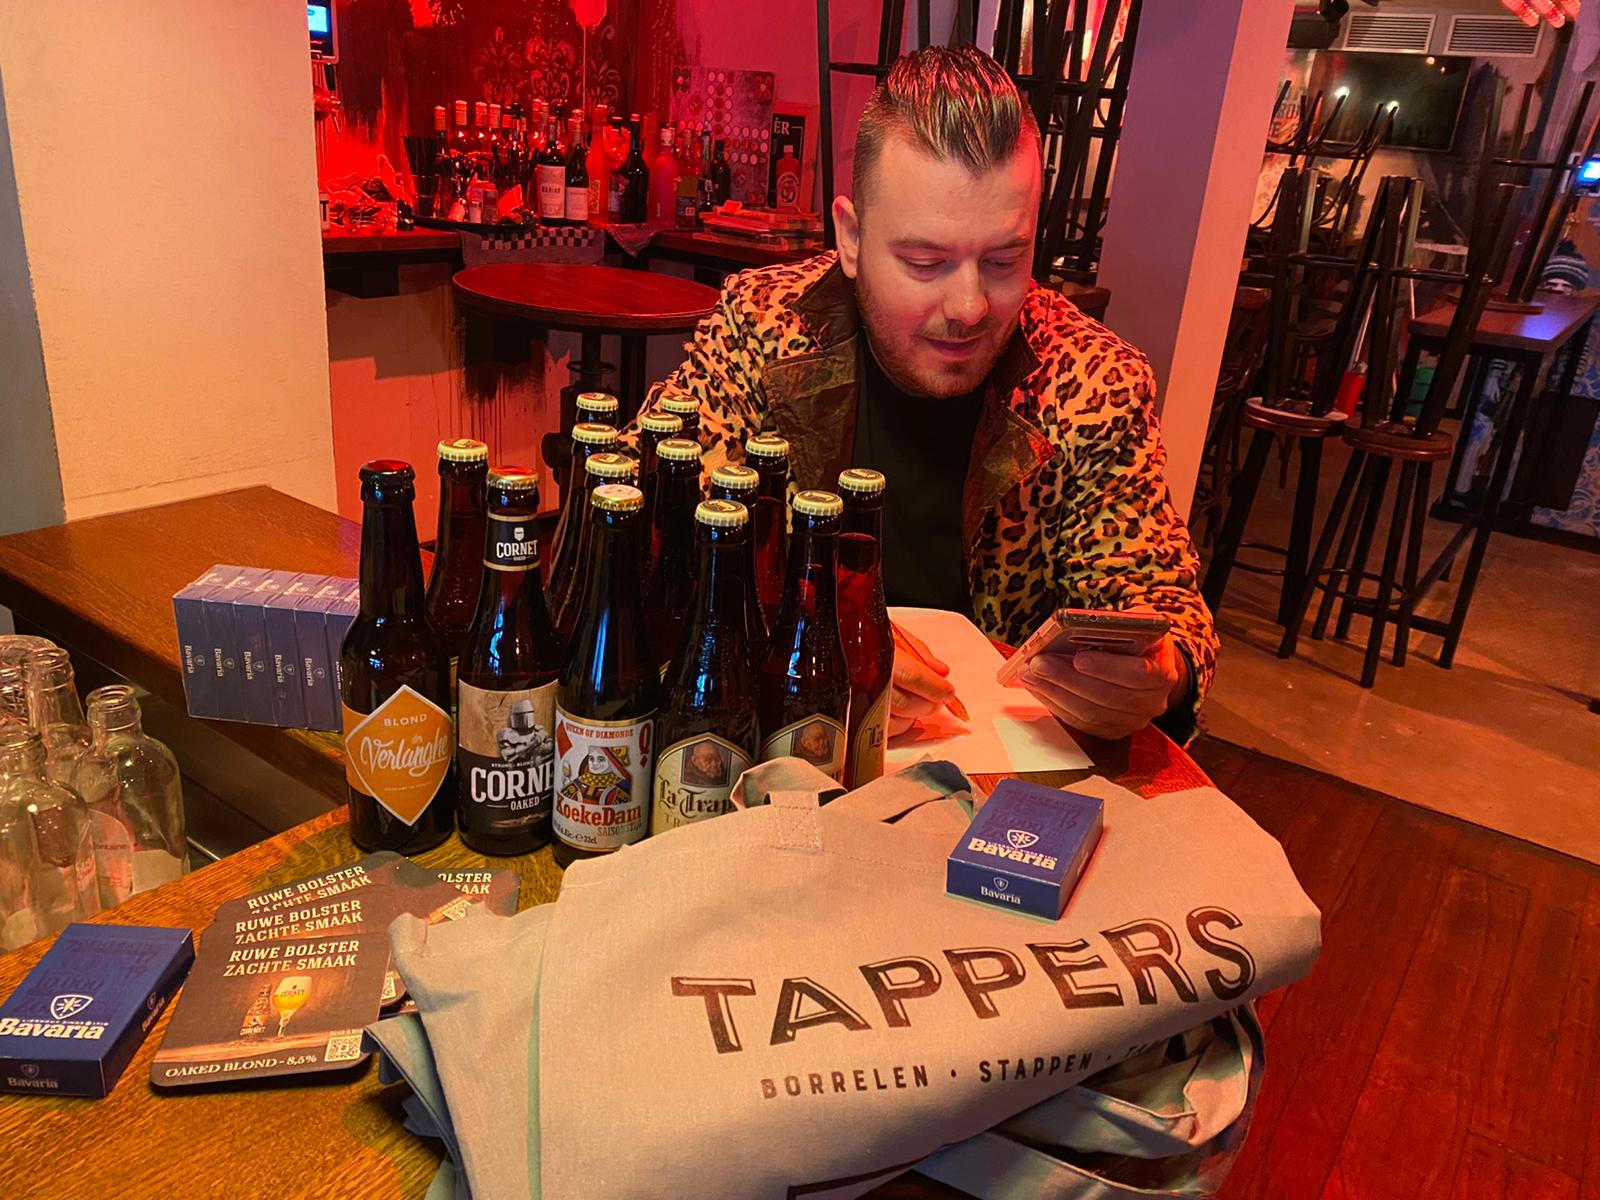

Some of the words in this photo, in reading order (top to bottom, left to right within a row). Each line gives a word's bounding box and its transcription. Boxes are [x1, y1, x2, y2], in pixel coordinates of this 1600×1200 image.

[496, 540, 538, 559] CORNET
[184, 645, 195, 673] Bavaria
[214, 648, 224, 677] Bavaria
[244, 651, 254, 680] Bavaria
[274, 654, 284, 683] Bavaria
[304, 657, 314, 687] Bavaria
[383, 713, 428, 727] BLOND
[595, 729, 634, 739] DIAMONDS
[639, 722, 652, 755] Q
[510, 796, 540, 811] OAKED
[658, 774, 677, 810] La
[556, 792, 641, 827] KoekeDam
[968, 837, 1058, 870] Bavaria
[246, 887, 294, 909] RUWE
[297, 865, 366, 892] BOLSTER
[317, 875, 372, 899] SMAAK
[455, 883, 490, 894] AAK
[980, 886, 1021, 905] Bavaria
[234, 924, 300, 945] ZACHTE
[305, 911, 364, 932] SMAAK
[235, 914, 284, 933] RUWE
[289, 899, 362, 923] BOLSTER
[223, 959, 291, 977] ZACHTE
[295, 954, 357, 971] SMAAK
[228, 946, 280, 963] RUWE
[284, 940, 360, 958] BOLSTER
[671, 906, 1256, 1054] TAPPERS
[0, 1017, 105, 1040] Bavaria
[165, 1063, 220, 1078] OAKED
[223, 1057, 278, 1073] BLOND
[287, 1054, 317, 1067] 8,5%
[761, 1065, 929, 1099] BORRELEN
[979, 1052, 1093, 1082] STAPPEN
[7, 1076, 58, 1089] Bavaria
